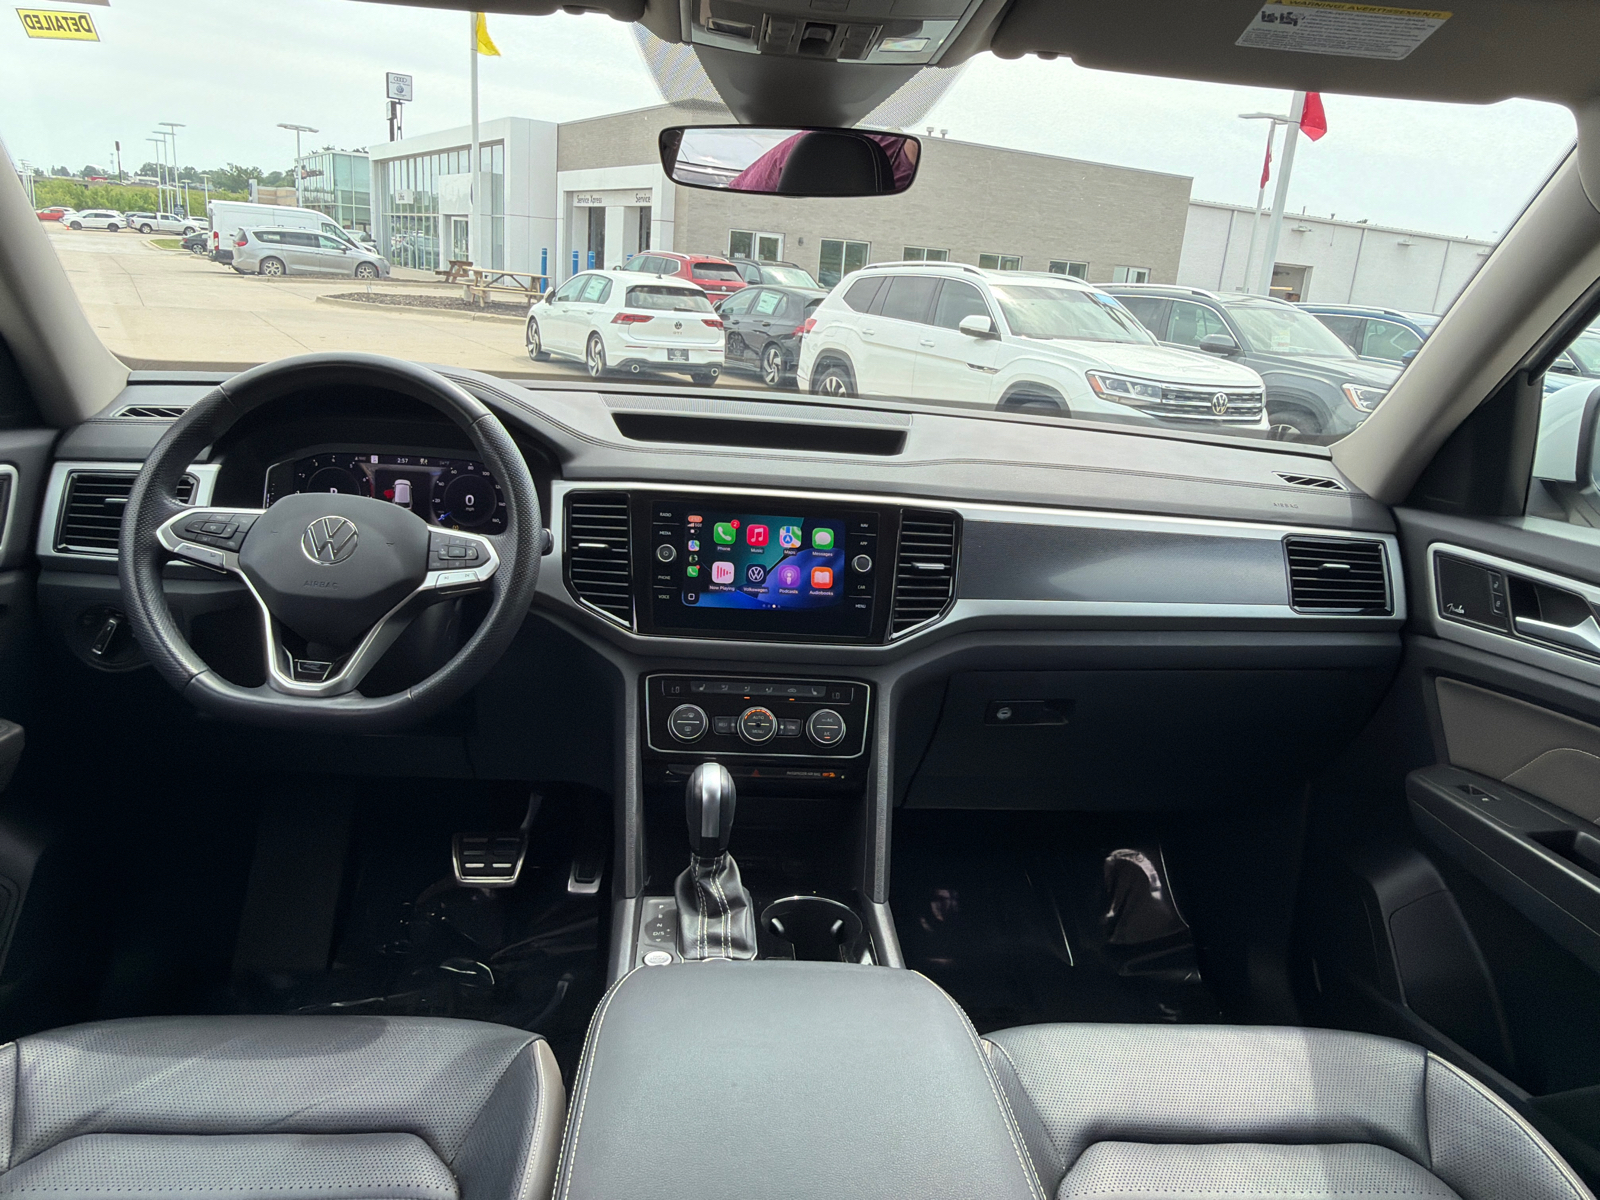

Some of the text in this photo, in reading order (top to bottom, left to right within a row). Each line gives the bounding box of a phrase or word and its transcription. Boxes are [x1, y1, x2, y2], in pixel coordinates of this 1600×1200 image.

[577, 195, 602, 205] Service Xpress
[635, 193, 651, 203] Service
[466, 494, 474, 506] 0
[303, 580, 339, 590] AIRBAG
